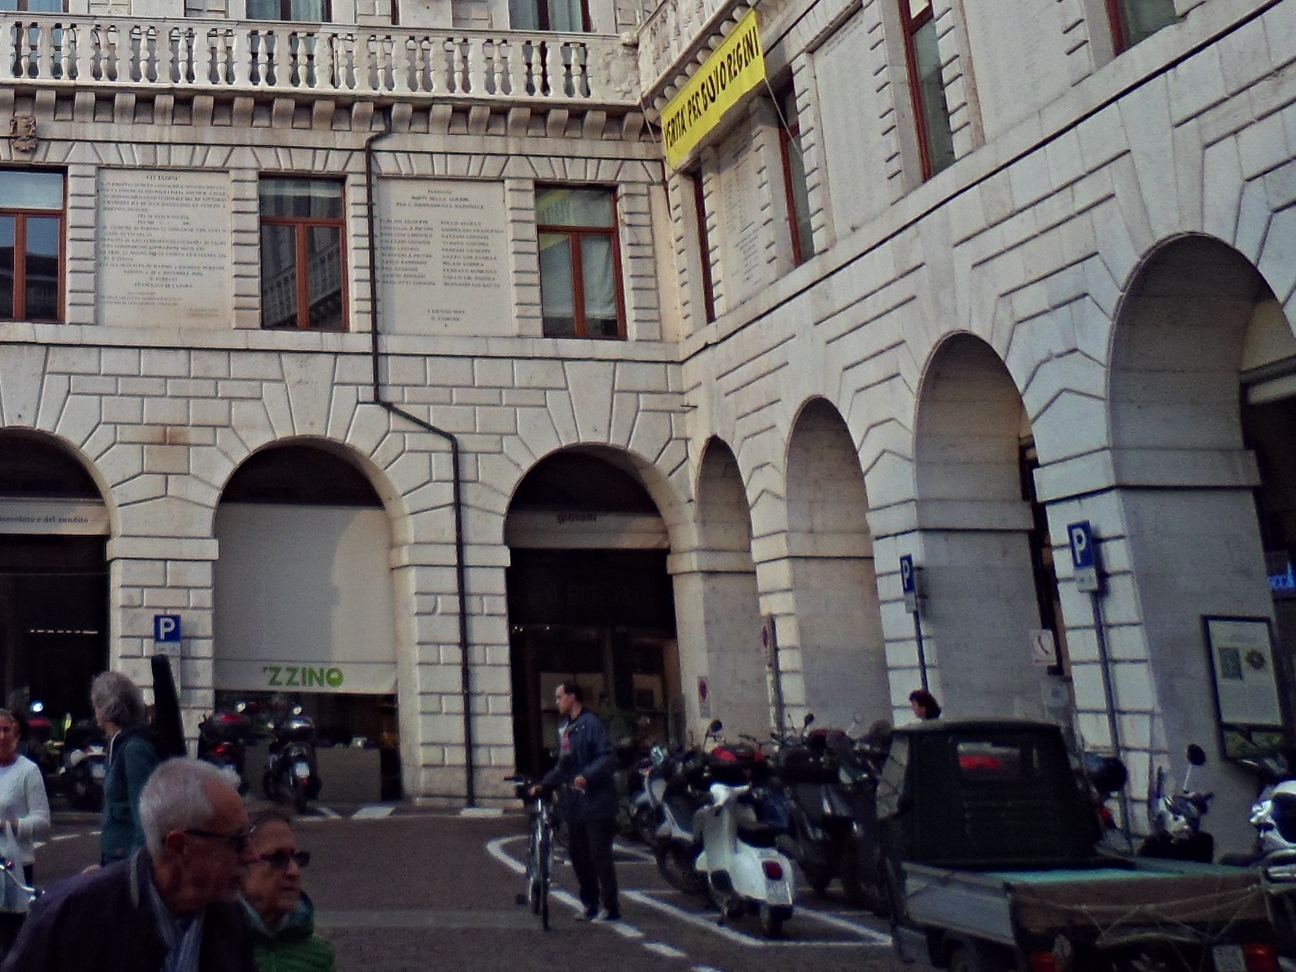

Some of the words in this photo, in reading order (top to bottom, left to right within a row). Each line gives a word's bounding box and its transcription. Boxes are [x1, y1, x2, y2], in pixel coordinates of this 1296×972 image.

[687, 92, 703, 127] PER
[727, 26, 759, 83] REGENI
[1071, 528, 1087, 564] P
[902, 560, 911, 588] P
[159, 617, 176, 640] P
[262, 666, 344, 688] ZZINO
